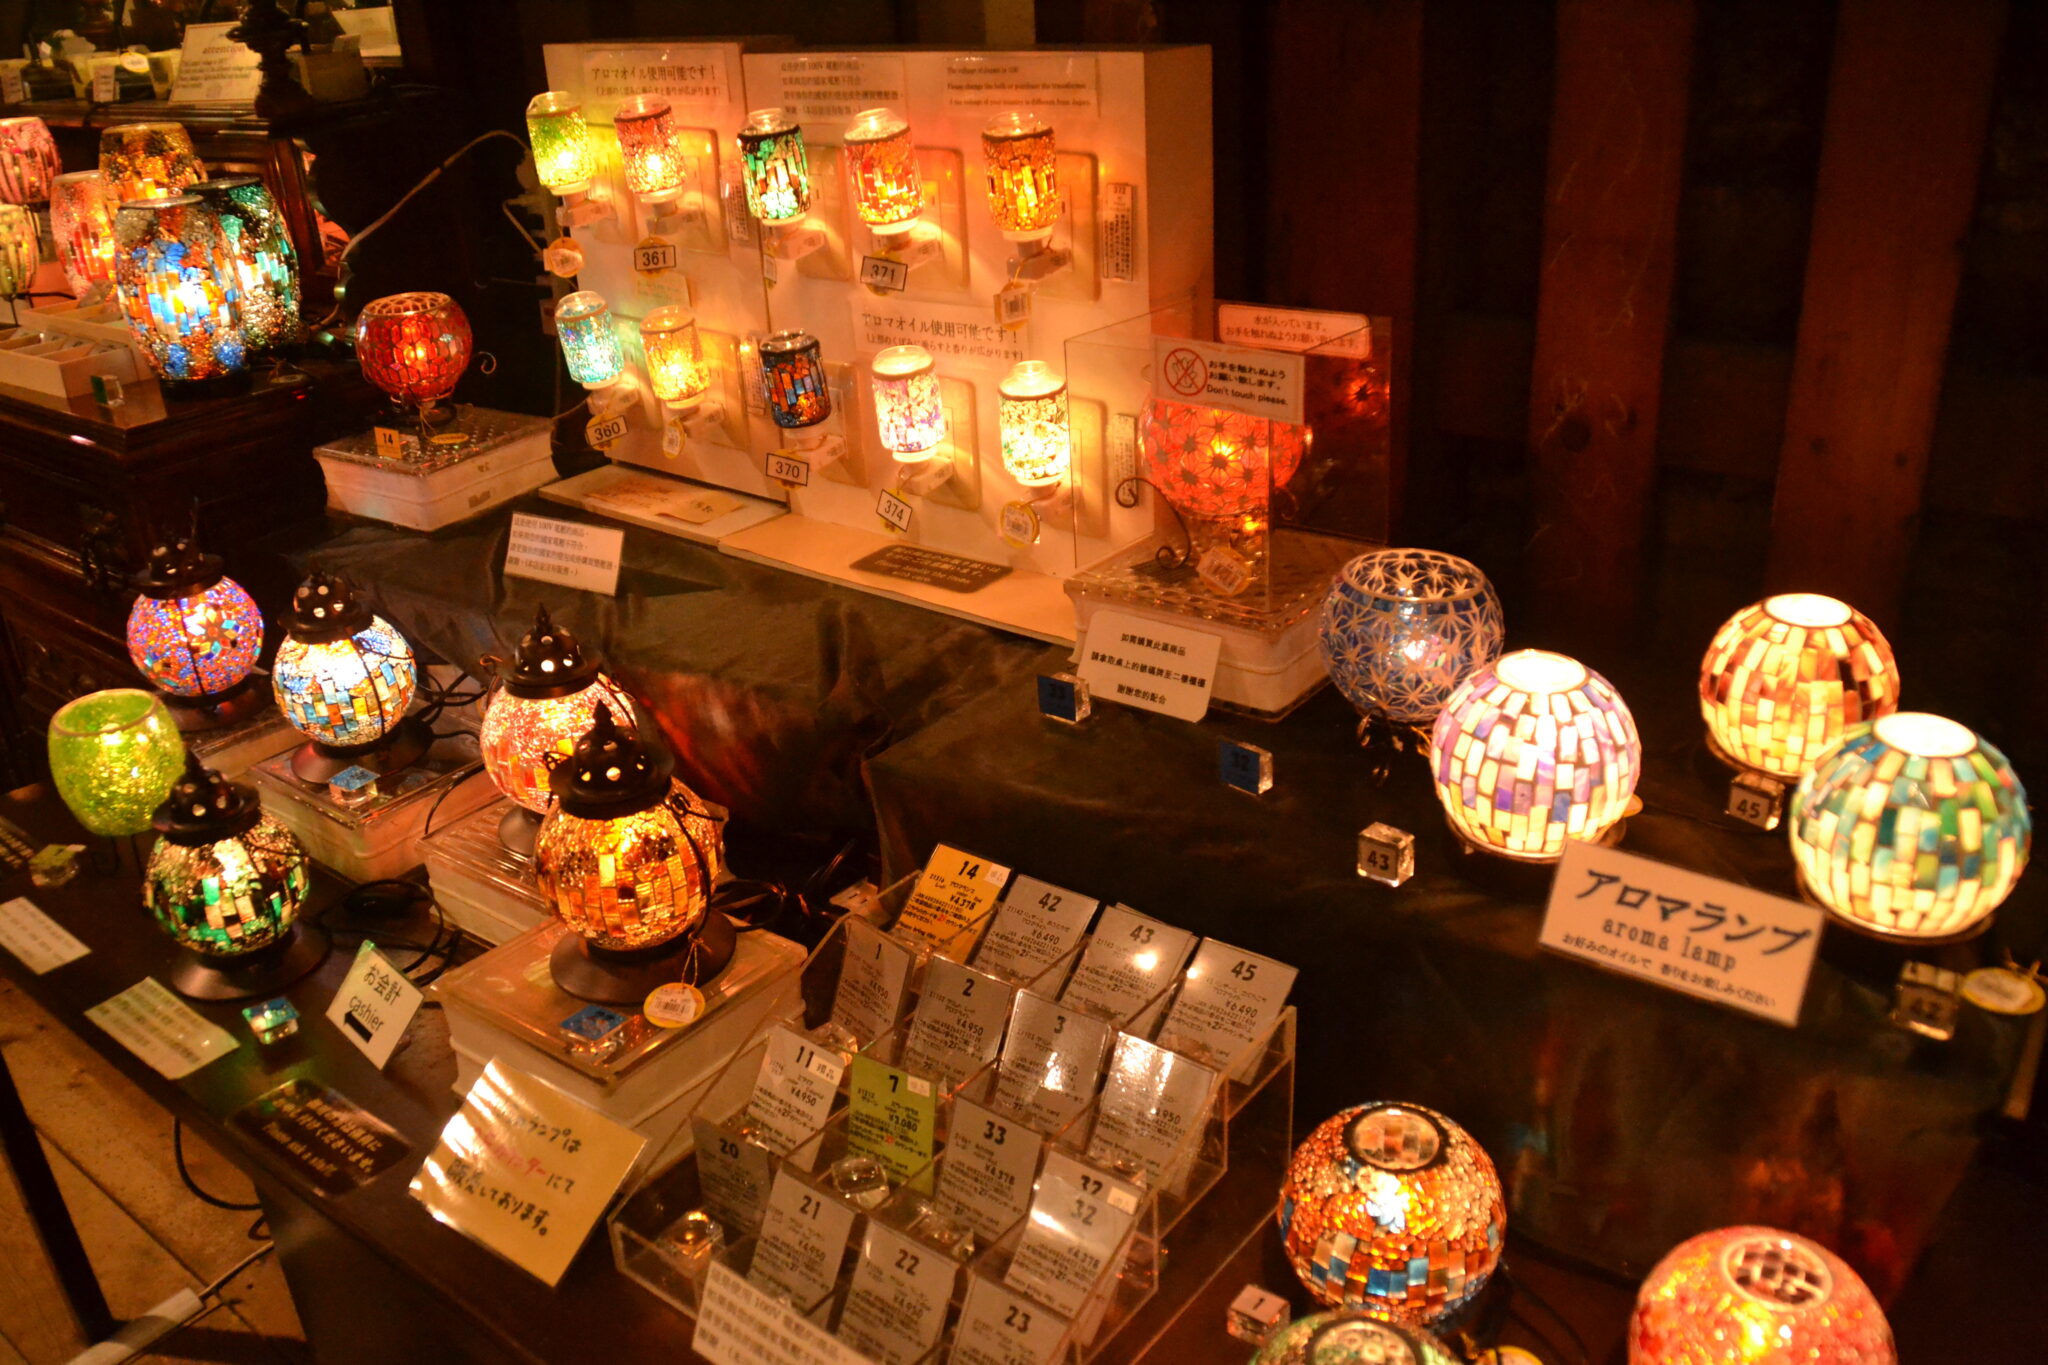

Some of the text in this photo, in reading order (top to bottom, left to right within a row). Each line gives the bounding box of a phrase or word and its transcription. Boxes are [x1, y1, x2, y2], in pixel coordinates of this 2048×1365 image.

[641, 250, 669, 267] 361
[869, 266, 897, 284] 371
[1208, 359, 1286, 380] お手を触れぬよう
[1208, 371, 1281, 391] お願い致します。
[1206, 384, 1288, 406] Don't touch please.
[383, 432, 394, 444] 14
[593, 421, 622, 441] 360
[775, 461, 801, 479] 370
[883, 499, 905, 522] 374
[1116, 683, 1167, 706] 謝謝您的配合
[1736, 798, 1761, 819] 45
[958, 860, 981, 880] 14
[1367, 850, 1389, 870] 43
[1038, 893, 1063, 913] 42
[1576, 869, 1812, 955] アロマランプ
[1129, 925, 1155, 945] 43
[1603, 918, 1737, 973] aroma lamp
[875, 943, 882, 960] 1
[1231, 960, 1258, 981] 45
[363, 963, 402, 1006] お会計
[962, 978, 975, 997] 2
[348, 996, 385, 1032] cashier
[1054, 1015, 1066, 1034] 3
[796, 1045, 815, 1069] 11
[888, 1075, 899, 1093] 7
[983, 1120, 1007, 1145] 33
[719, 1138, 739, 1160] 20
[800, 1195, 821, 1220] 21
[894, 1248, 920, 1275] 22
[1004, 1305, 1031, 1334] 23
